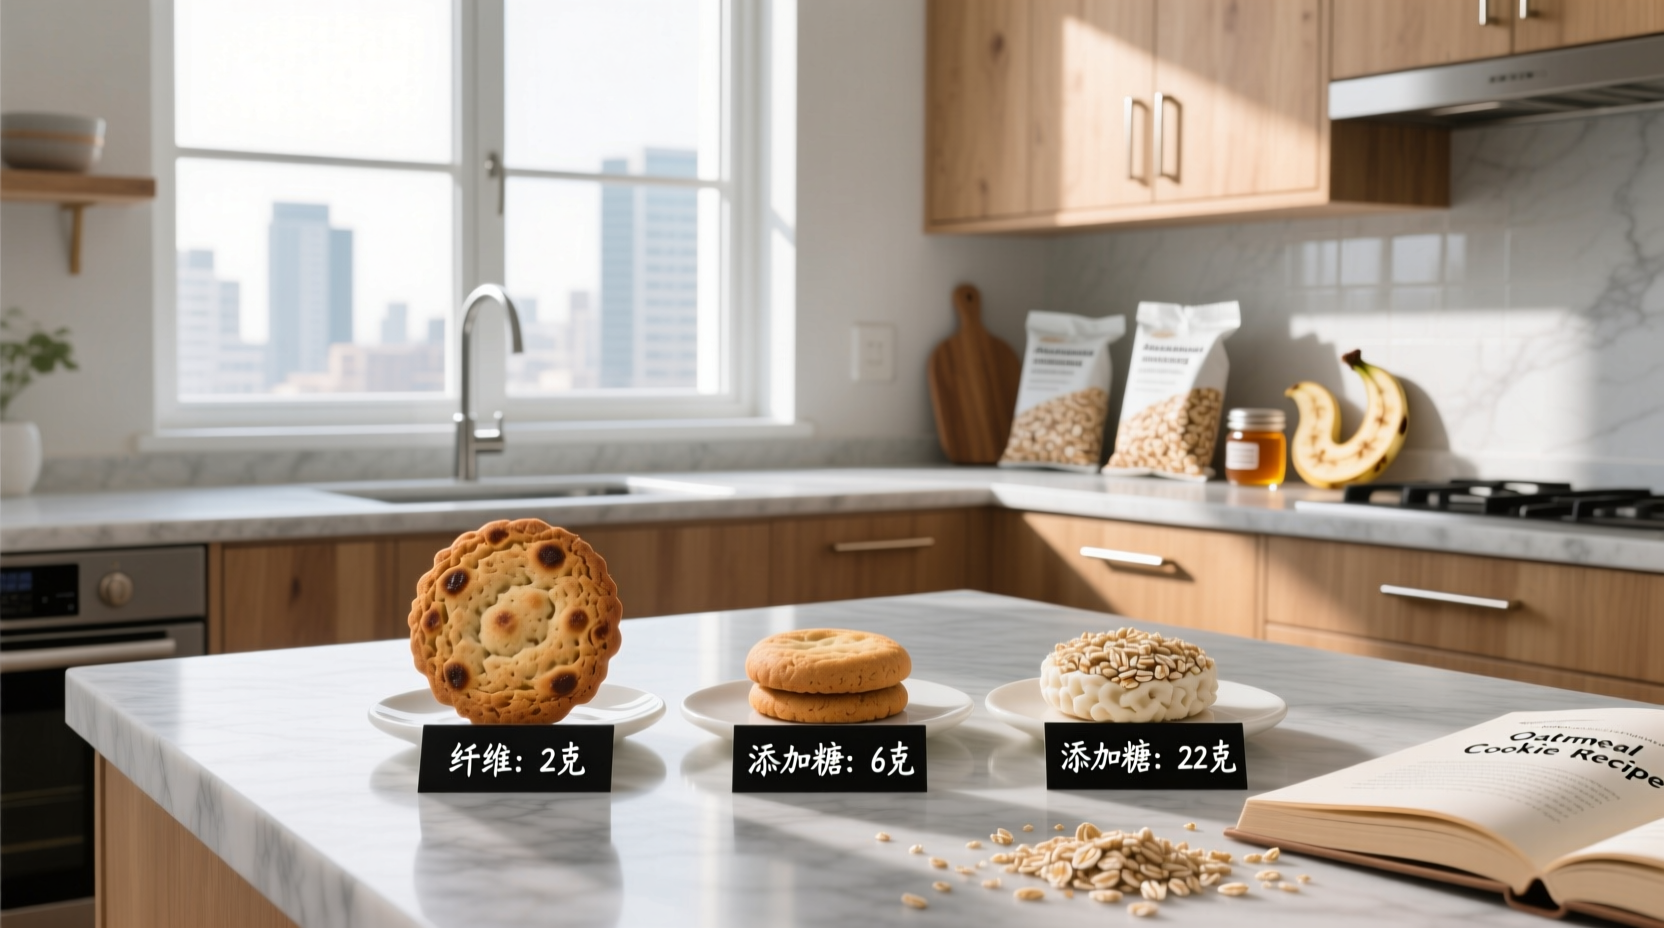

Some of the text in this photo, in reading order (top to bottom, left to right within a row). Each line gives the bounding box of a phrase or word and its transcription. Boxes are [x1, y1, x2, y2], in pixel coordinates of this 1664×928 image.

[1509, 731, 1644, 757] Oatmeal
[1464, 742, 1664, 789] Cookie Recipe
